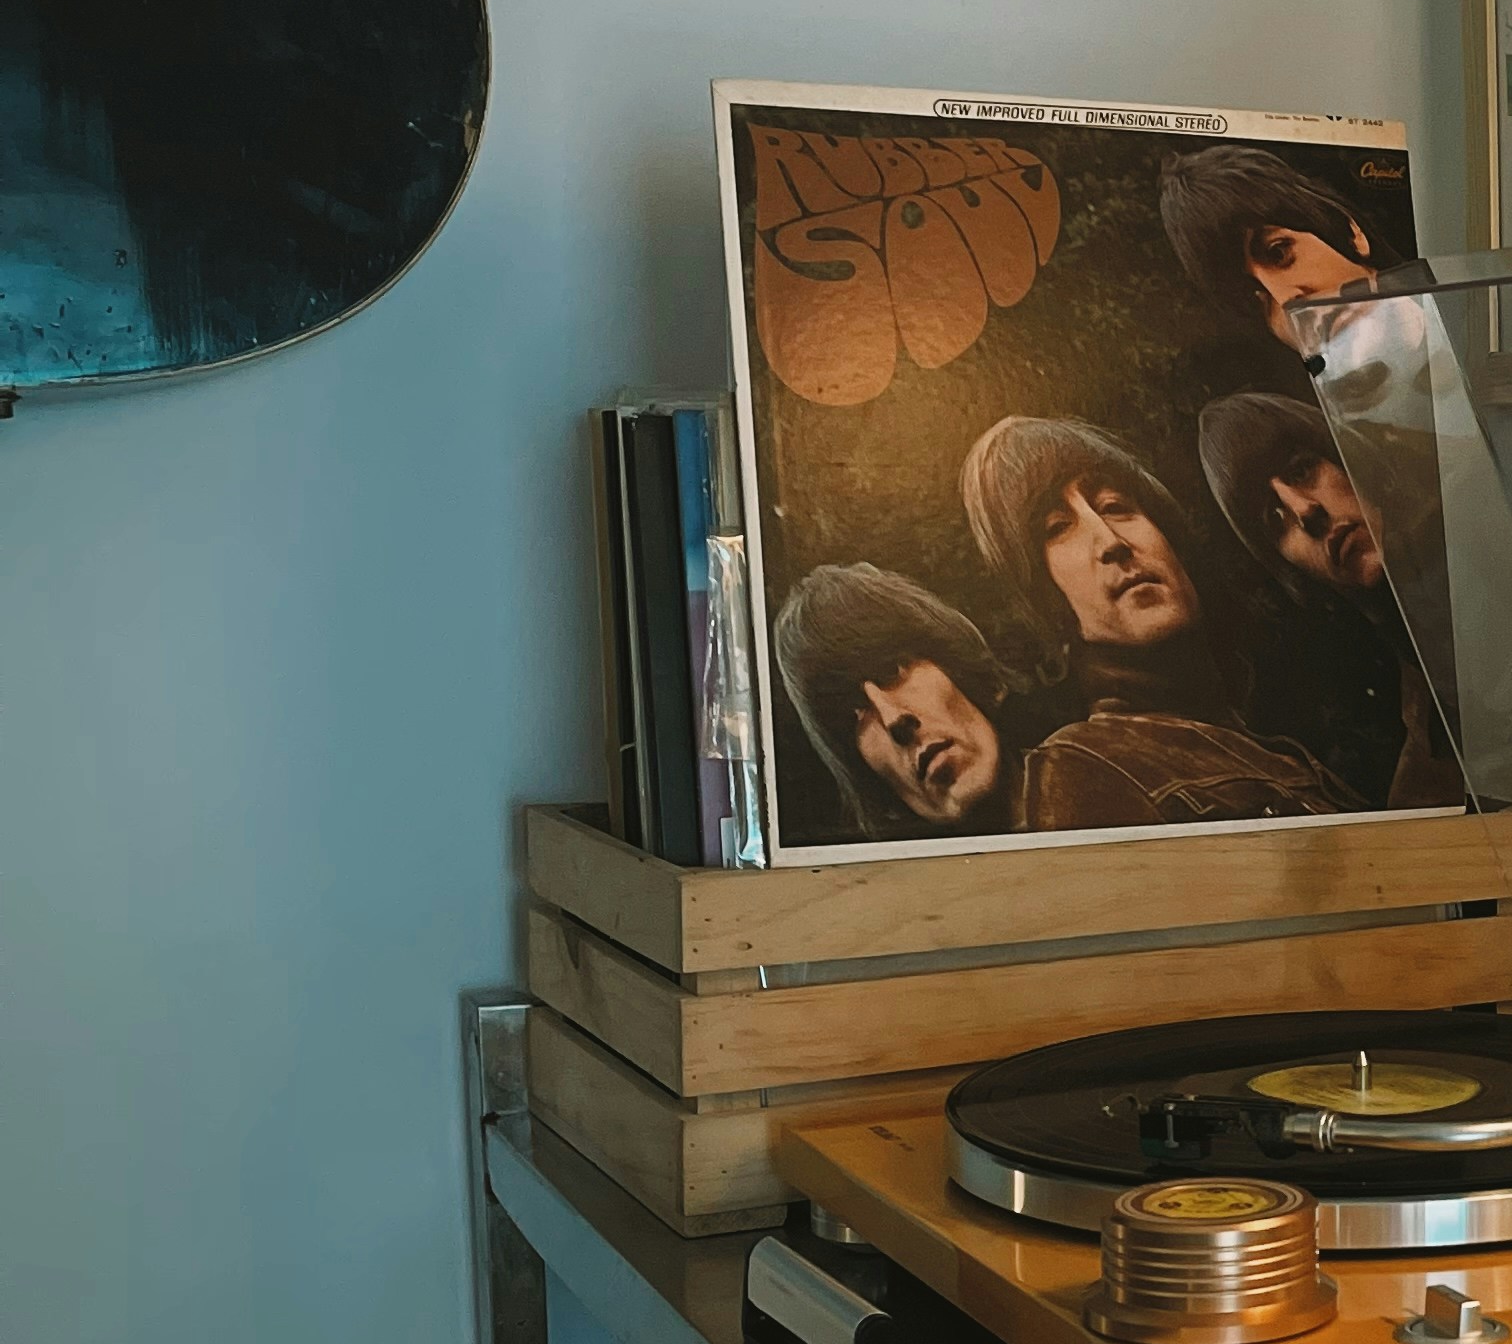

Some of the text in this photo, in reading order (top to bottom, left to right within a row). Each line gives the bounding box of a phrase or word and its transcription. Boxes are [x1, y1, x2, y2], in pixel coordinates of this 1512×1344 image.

[941, 103, 1221, 131] NEW IMPROVED FULL DIMENSIONAL STEREO
[747, 122, 1043, 234] RUBBER
[755, 164, 1061, 406] SOUL
